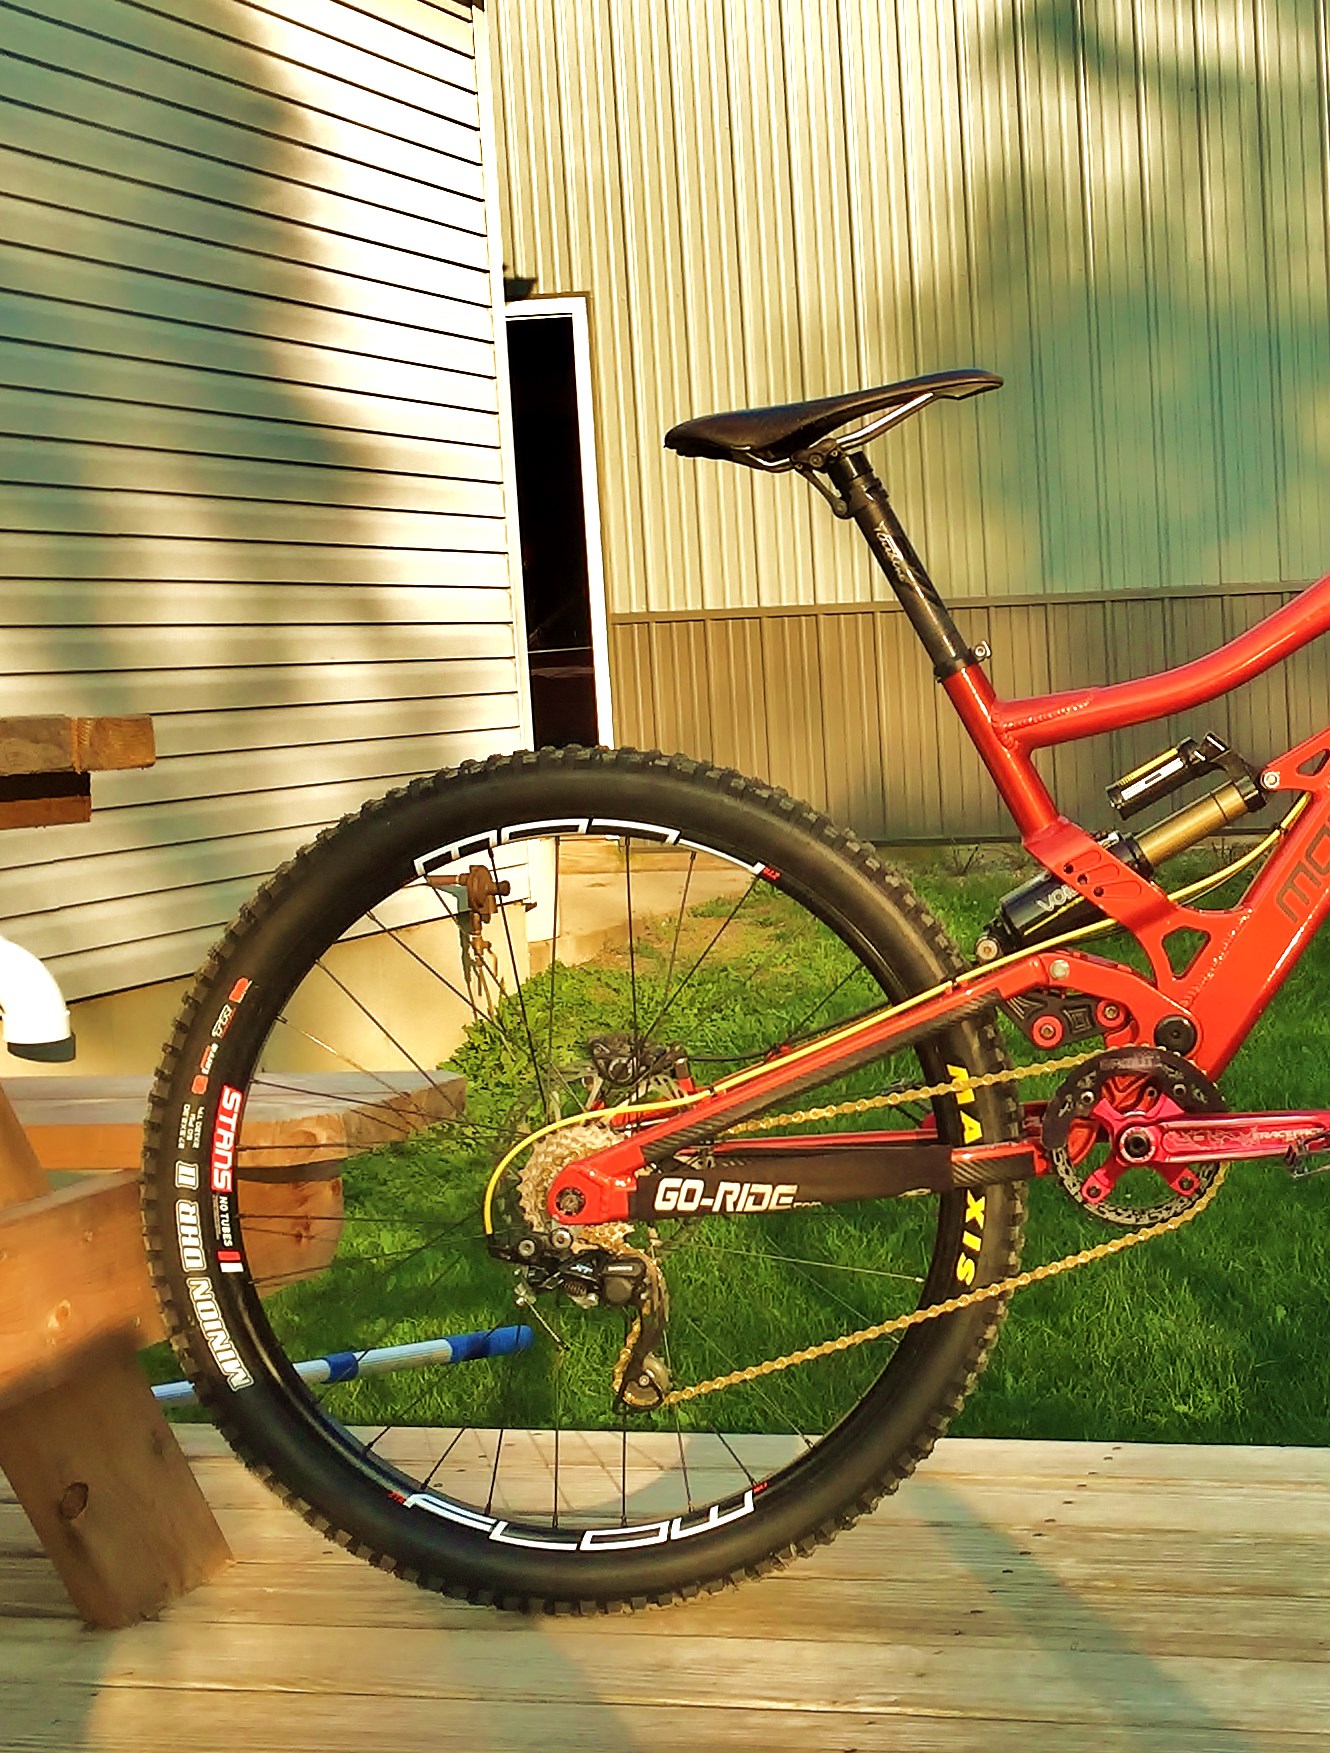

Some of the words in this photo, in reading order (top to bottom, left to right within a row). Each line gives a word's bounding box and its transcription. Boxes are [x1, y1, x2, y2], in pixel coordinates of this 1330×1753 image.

[212, 1087, 242, 1193] STANS
[946, 1064, 986, 1286] MAXIS
[175, 1200, 207, 1272] DHR
[218, 1195, 229, 1214] NO
[219, 1216, 233, 1248] TUBES
[186, 1278, 255, 1392] MINION
